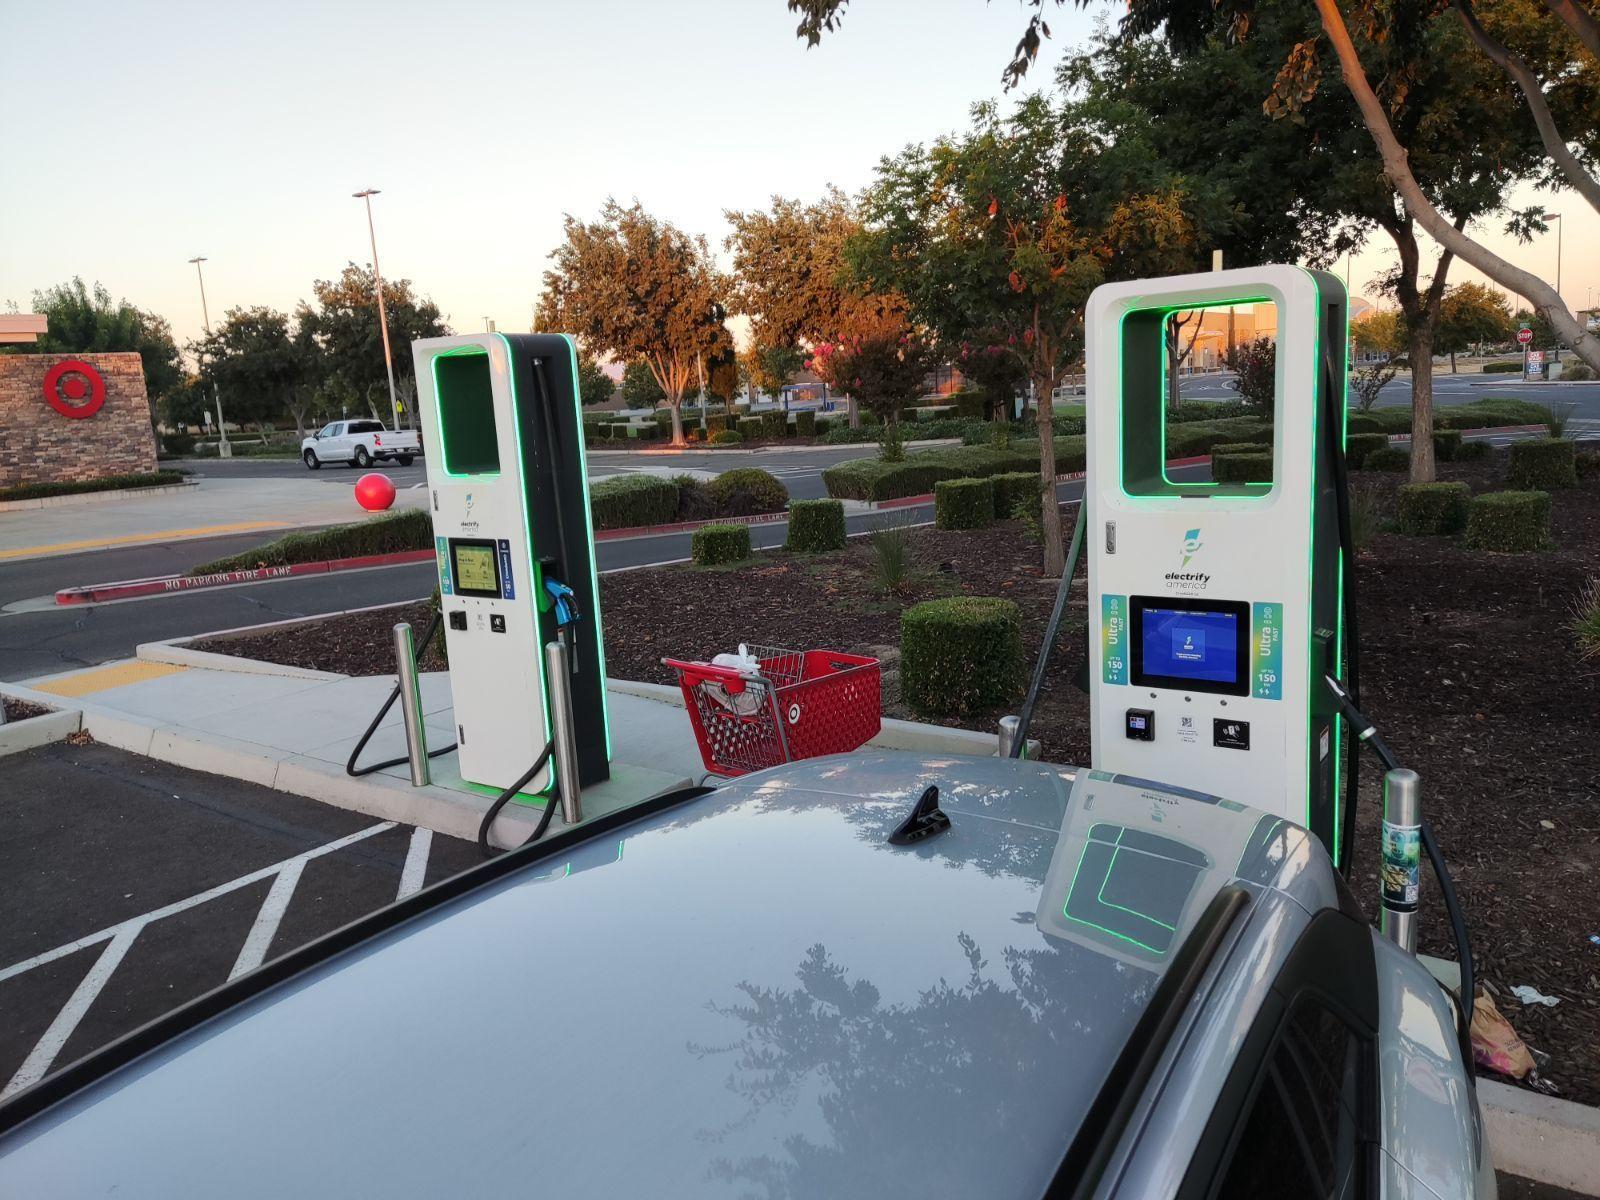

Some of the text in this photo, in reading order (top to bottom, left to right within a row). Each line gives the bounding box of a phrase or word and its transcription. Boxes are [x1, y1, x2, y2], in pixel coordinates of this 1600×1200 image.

[165, 566, 292, 590] NO PARKING FIRE LANE
[1165, 572, 1211, 583] electrify
[1166, 581, 1207, 590] america
[1108, 617, 1118, 644] Ultra
[1259, 626, 1271, 656] Ultra
[1108, 660, 1123, 669] 150
[1259, 673, 1276, 682] 150
